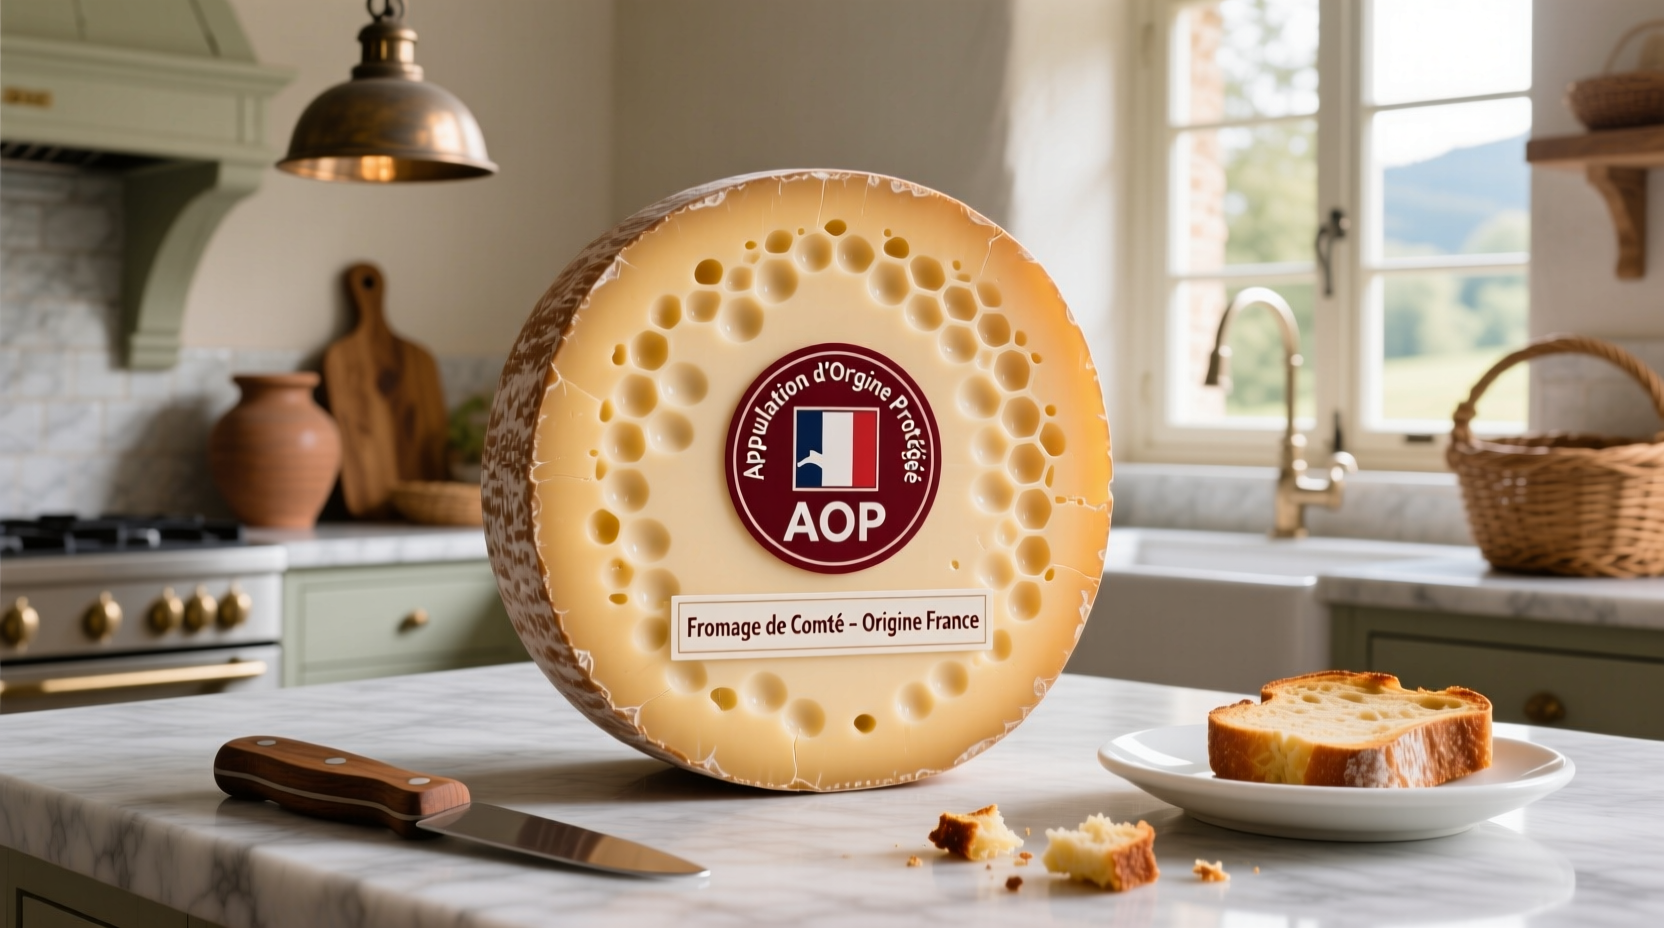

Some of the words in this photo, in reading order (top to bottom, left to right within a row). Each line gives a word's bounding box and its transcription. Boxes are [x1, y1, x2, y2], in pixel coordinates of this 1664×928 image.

[813, 361, 892, 402] d'Orgine
[783, 500, 886, 542] AOP
[687, 616, 762, 642] Fromage
[765, 613, 787, 636] de
[790, 612, 845, 635] Comté
[862, 611, 923, 638] Origine
[926, 610, 980, 631] France
